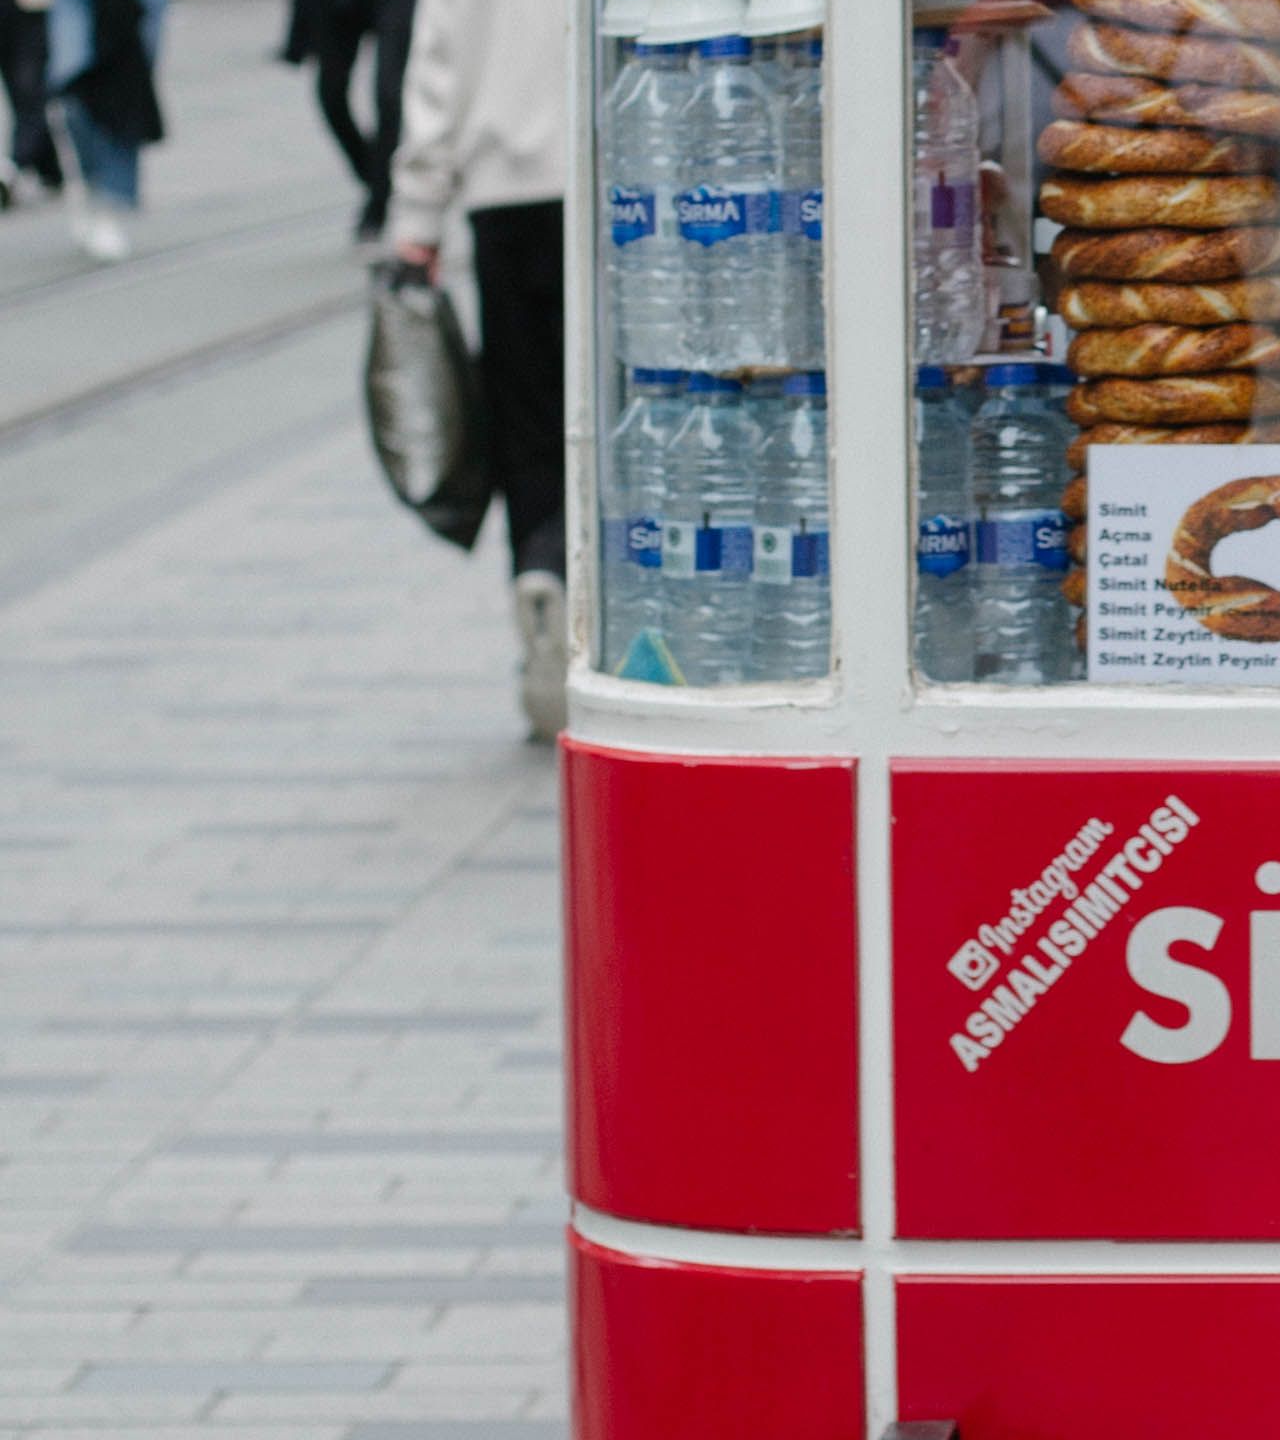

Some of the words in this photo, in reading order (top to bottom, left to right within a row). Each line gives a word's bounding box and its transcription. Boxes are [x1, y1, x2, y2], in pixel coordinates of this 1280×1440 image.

[1098, 503, 1148, 517] Simit
[1098, 529, 1152, 545] Açma
[1098, 553, 1148, 569] Çatal
[1098, 577, 1147, 592] Simit
[1098, 602, 1147, 617] Simit
[1098, 627, 1147, 642] Simit
[1153, 627, 1213, 645] Zeytin
[1098, 652, 1147, 667] Simit
[1153, 652, 1213, 670] Zeytin
[1219, 652, 1278, 670] Peynir
[977, 817, 1115, 956] Instagram
[948, 793, 1201, 1073] ASMALISIMITCISI
